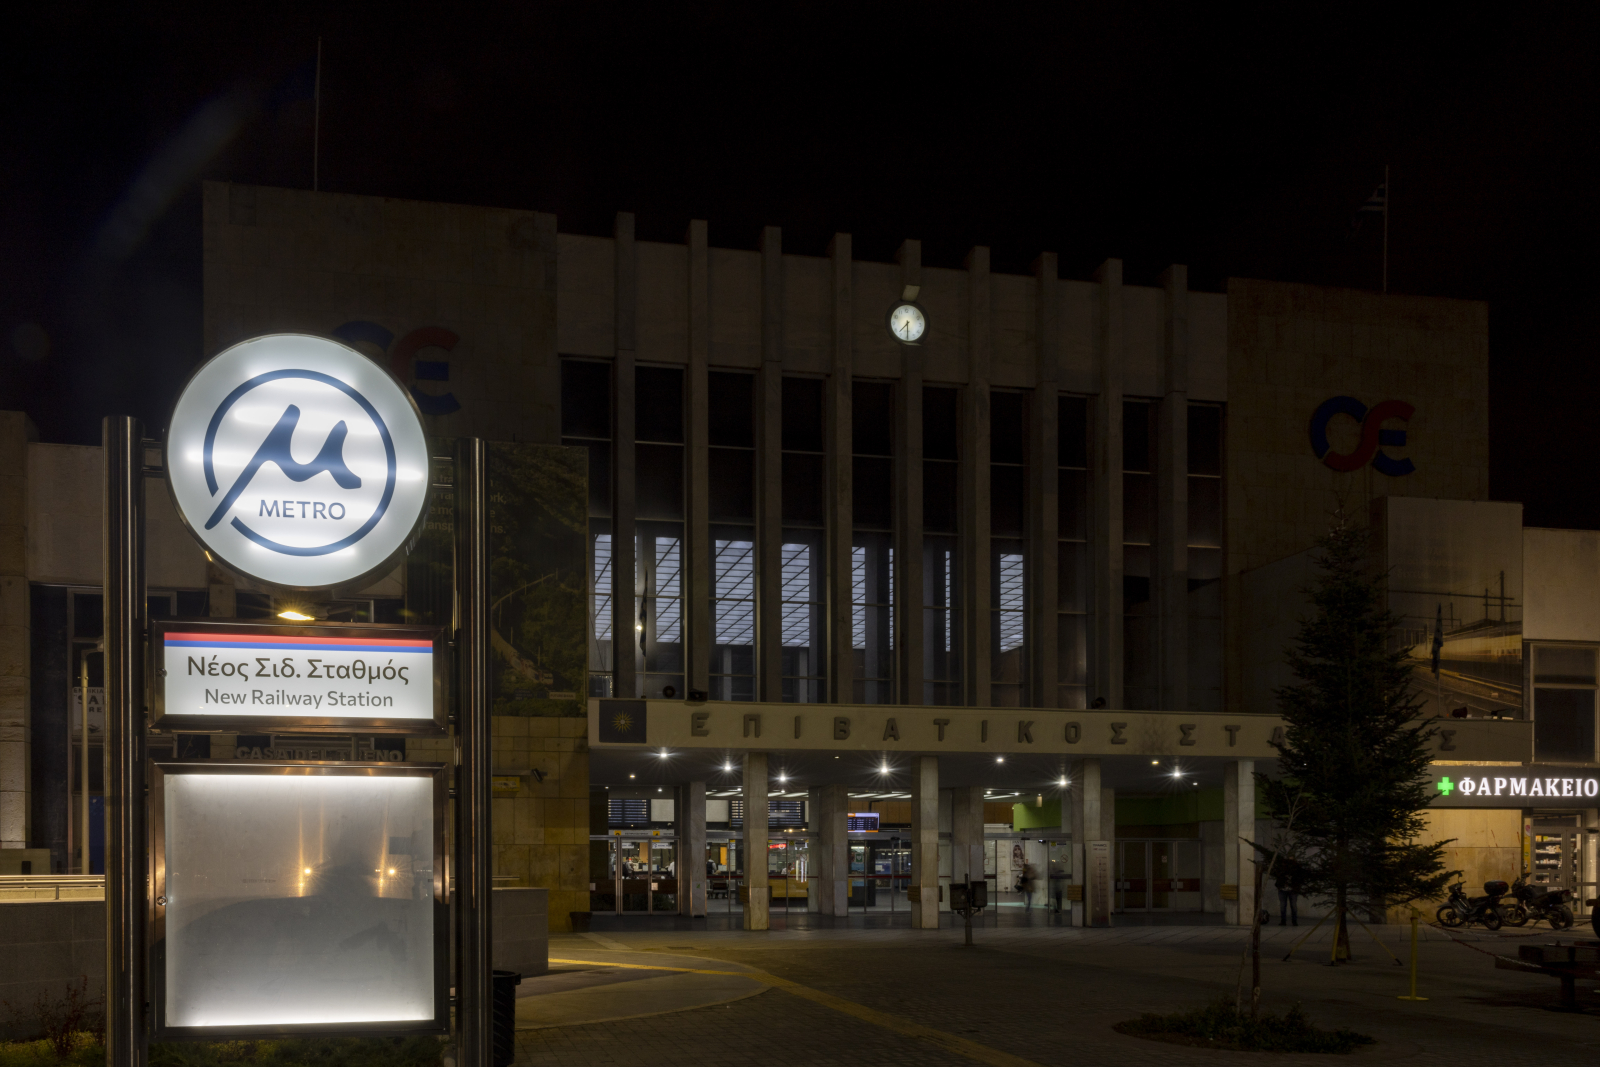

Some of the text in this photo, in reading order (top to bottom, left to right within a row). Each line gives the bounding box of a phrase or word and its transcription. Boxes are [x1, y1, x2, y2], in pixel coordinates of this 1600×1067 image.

[258, 499, 346, 520] METRO
[187, 655, 409, 685] Νέος Σιδ. Σταθμός
[205, 688, 393, 709] New Railway Station
[691, 712, 1128, 746] ΕΠΙΒΑΤΙΚΟΣ
[236, 746, 289, 760] CASA
[1458, 776, 1599, 797] ΦΑΡΜΑΚΕΙΟ
